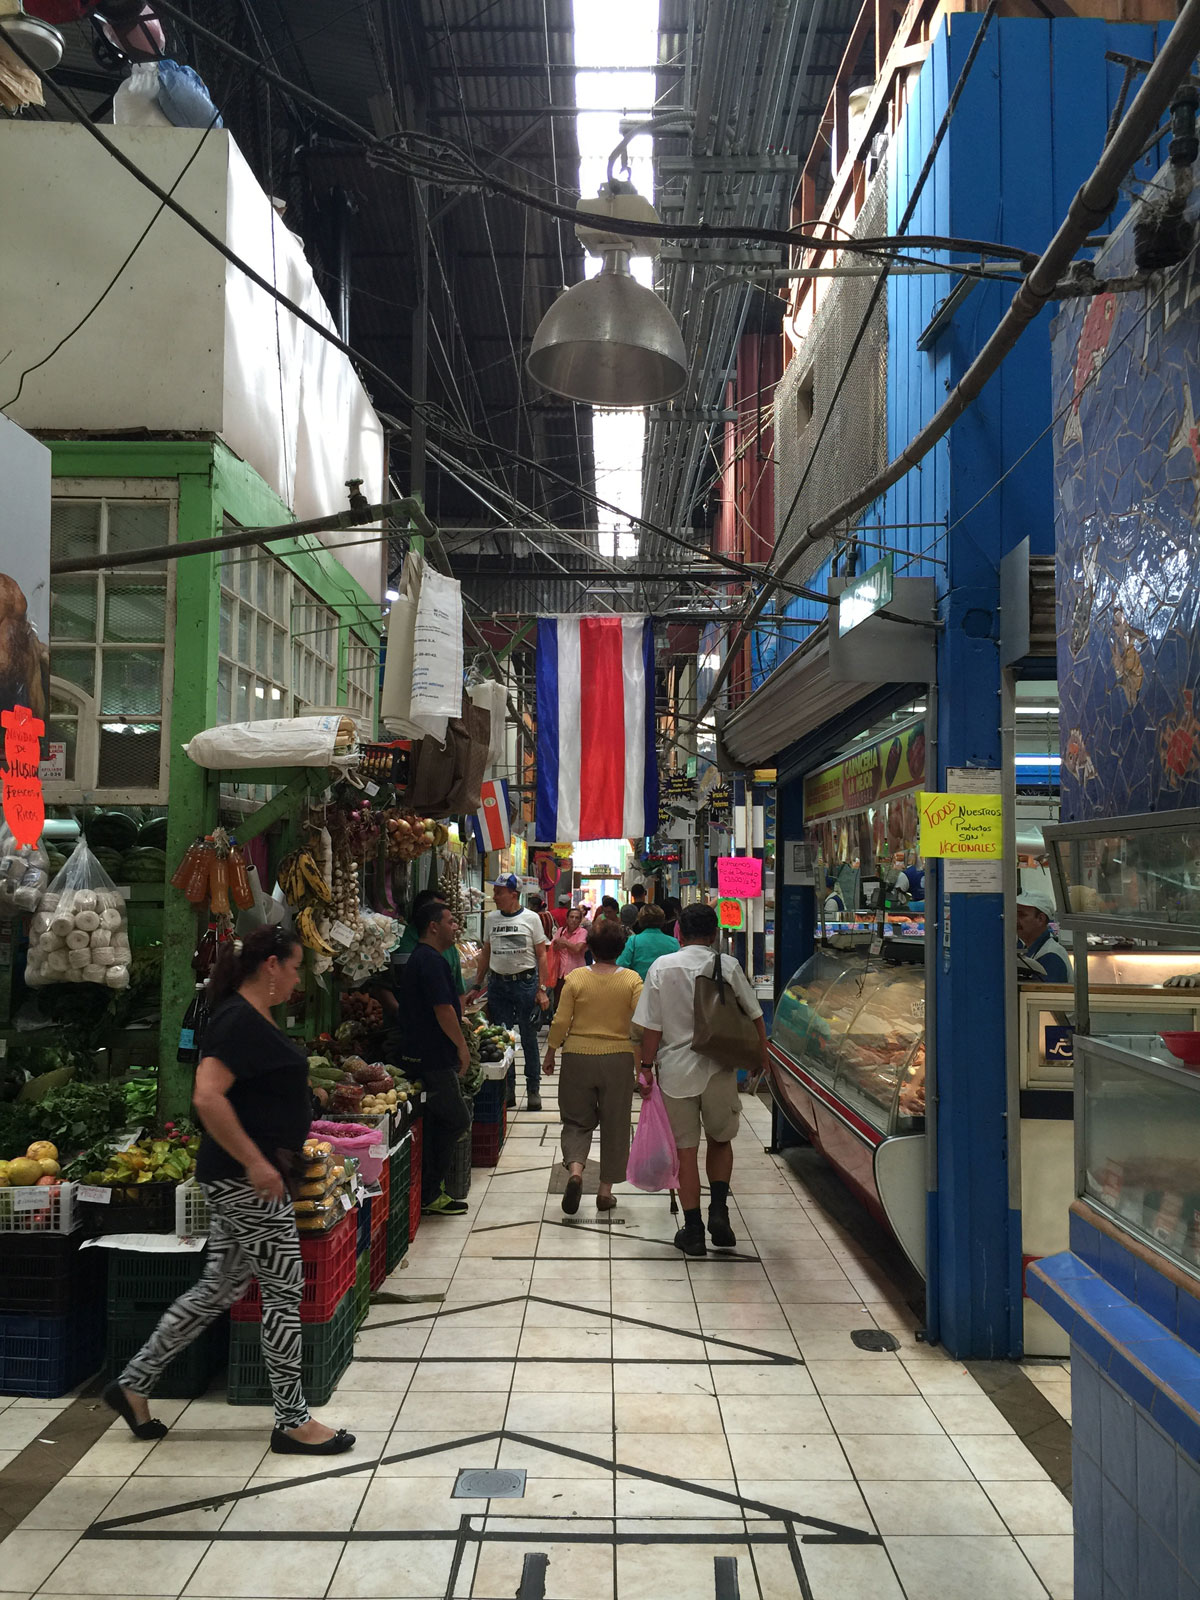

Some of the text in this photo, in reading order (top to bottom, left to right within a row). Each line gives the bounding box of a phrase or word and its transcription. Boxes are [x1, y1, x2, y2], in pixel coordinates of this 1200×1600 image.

[923, 796, 956, 829] TODOS
[950, 816, 992, 832] Productos
[959, 833, 979, 842] SON
[940, 840, 997, 855] NACIONALES
